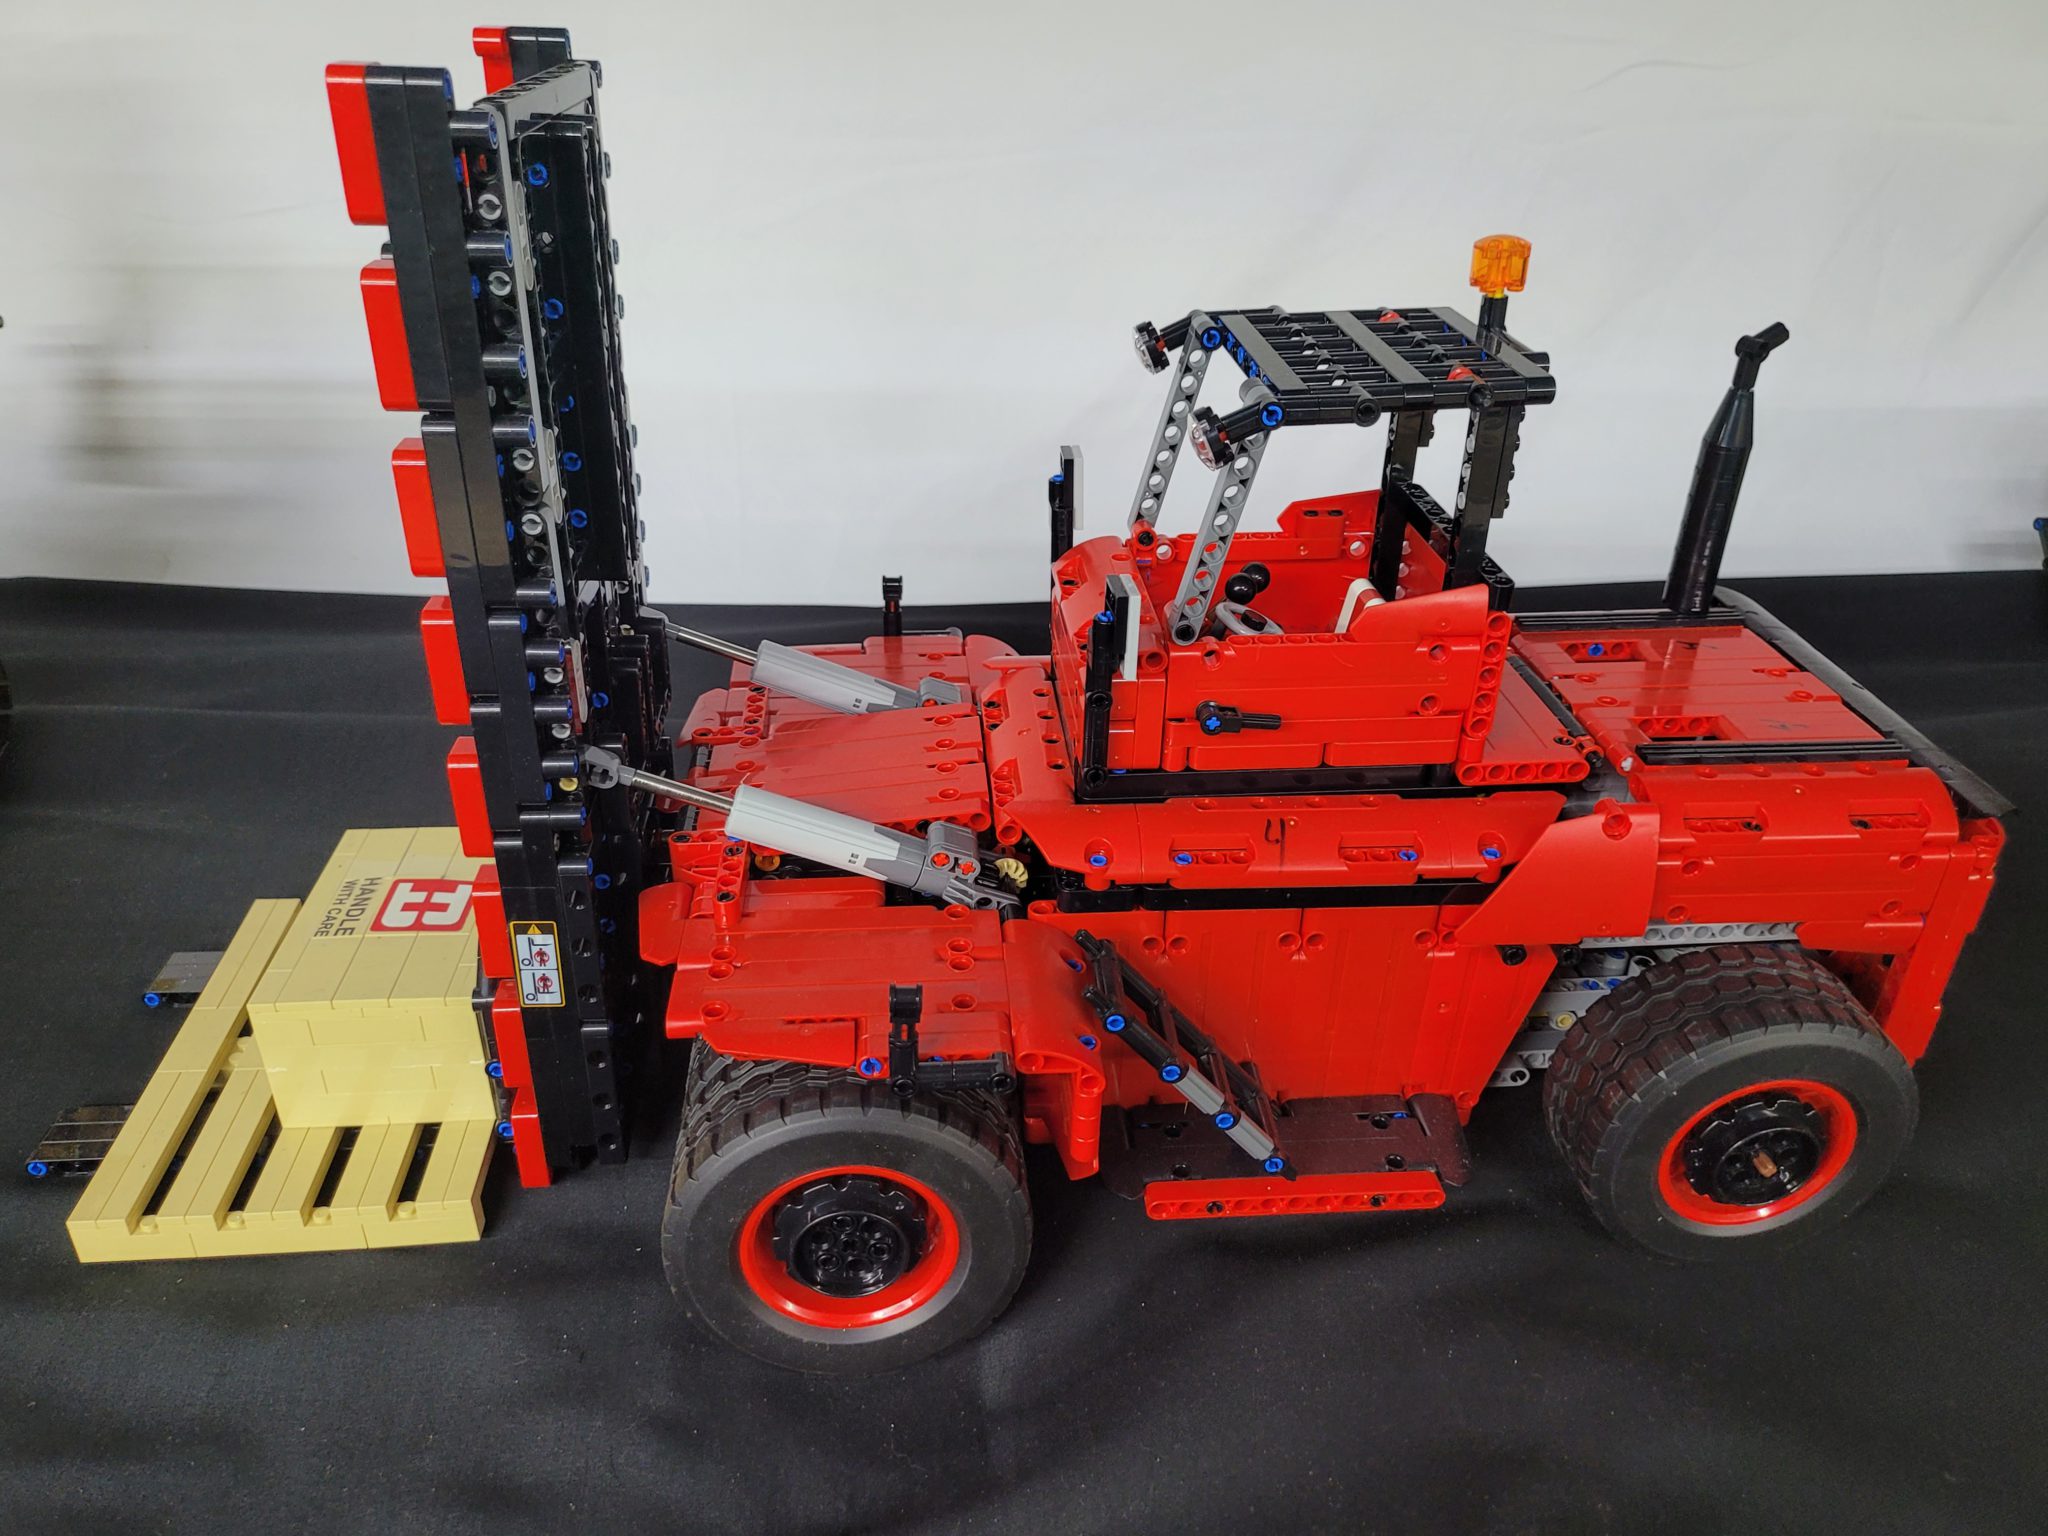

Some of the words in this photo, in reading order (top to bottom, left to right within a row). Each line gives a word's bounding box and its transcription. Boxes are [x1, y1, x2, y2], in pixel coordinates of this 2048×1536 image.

[333, 879, 360, 905] WITH
[333, 877, 383, 936] HANDLE
[313, 908, 342, 937] CARE
